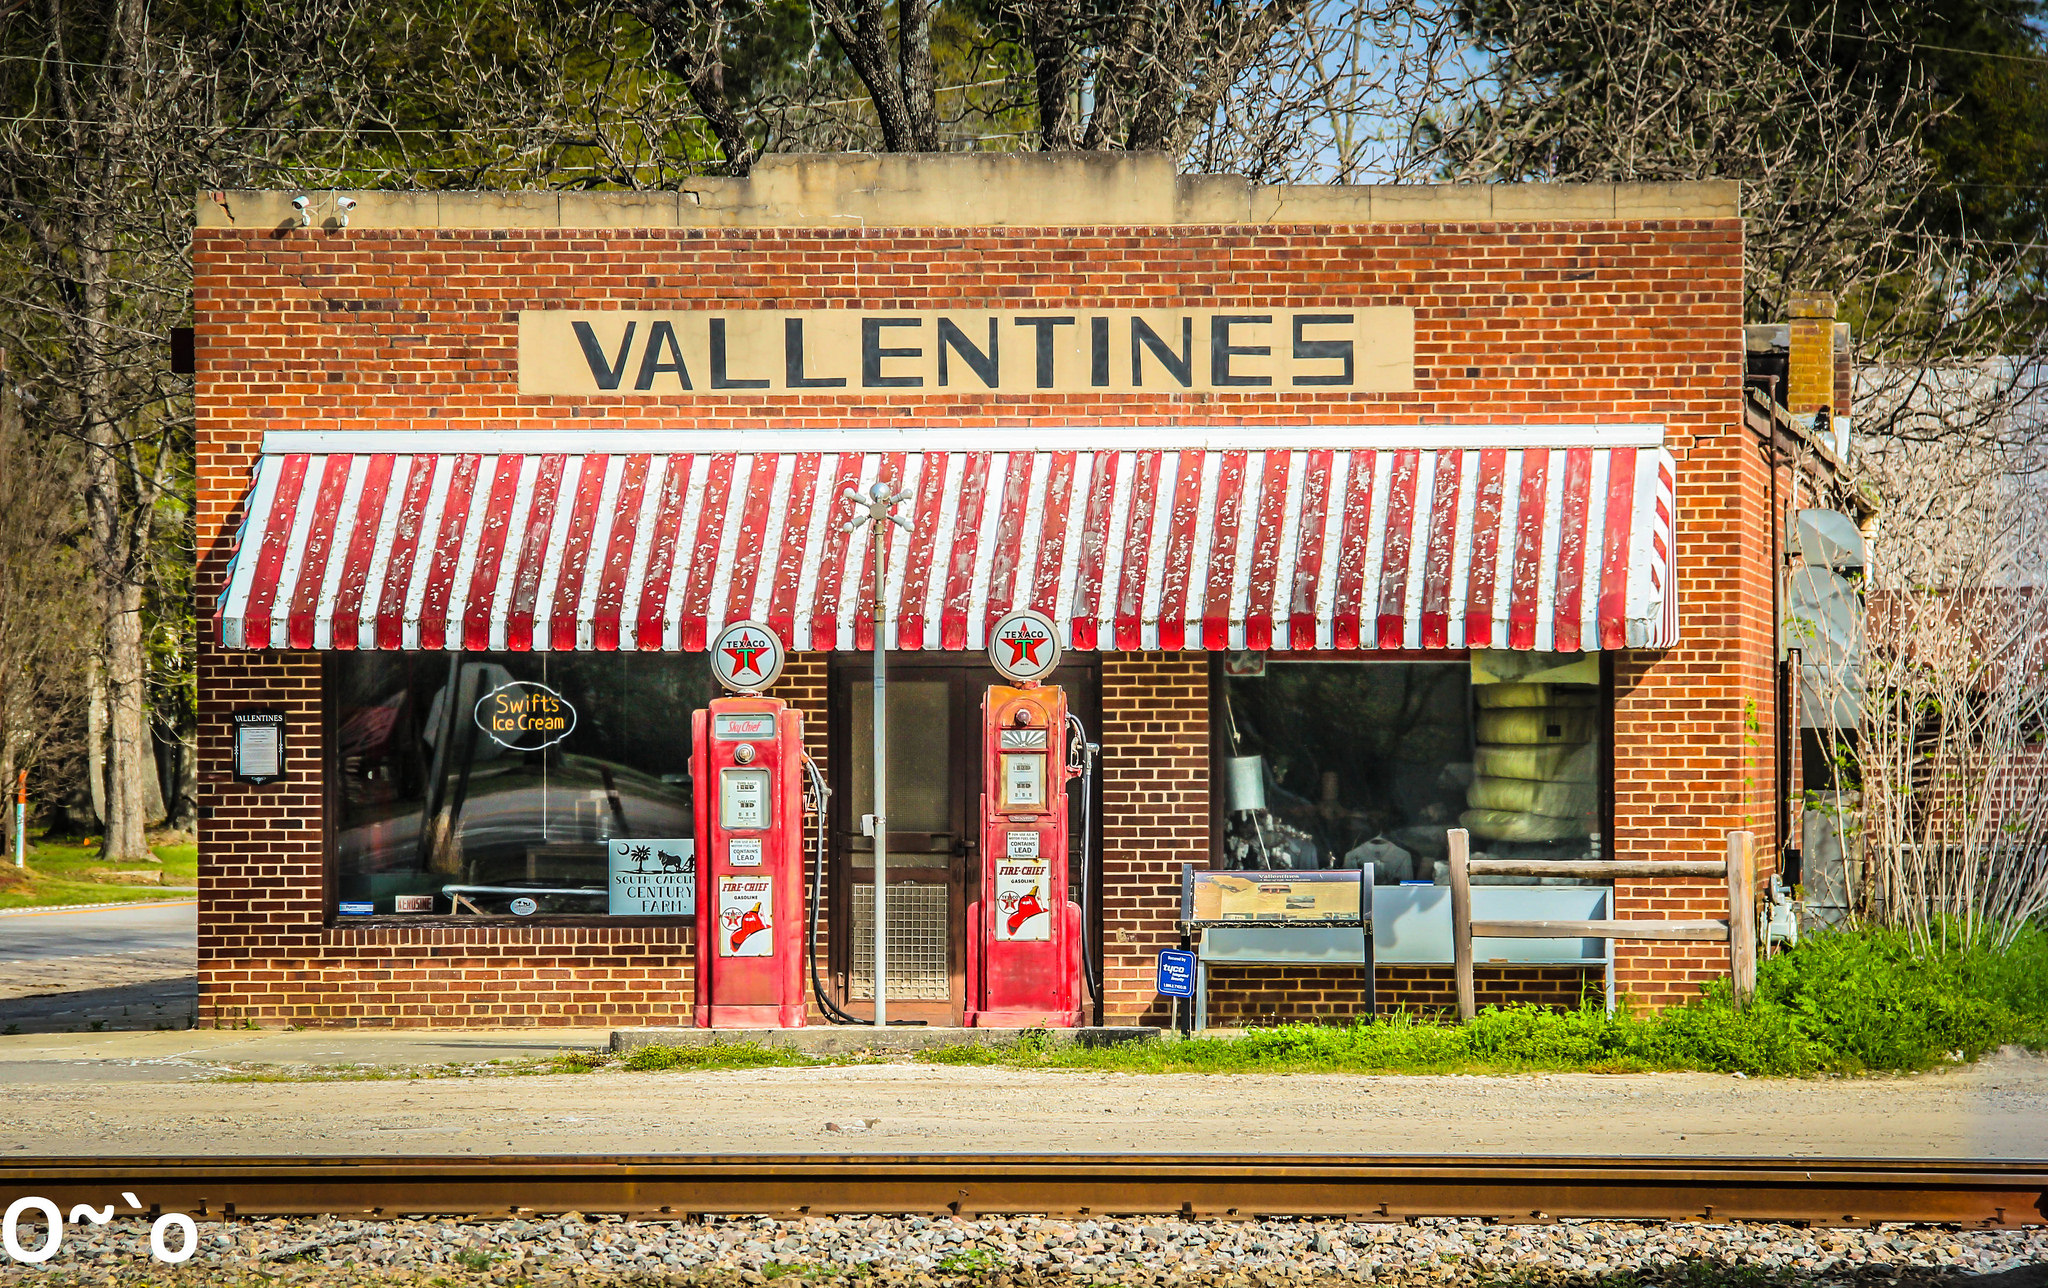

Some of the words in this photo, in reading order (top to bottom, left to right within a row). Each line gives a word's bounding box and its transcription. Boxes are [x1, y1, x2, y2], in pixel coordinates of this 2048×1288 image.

[571, 313, 1355, 390] VALLENTINES
[1005, 630, 1044, 638] TEXACO
[726, 640, 765, 648] TEXACO
[496, 693, 560, 714] Swift's
[234, 714, 283, 722] VALLENTINES
[492, 715, 515, 731] Ice
[517, 713, 565, 731] Cream
[728, 721, 741, 733] Sky
[742, 721, 762, 732] Chief
[999, 866, 1047, 876] FIRE-CHIEF
[615, 875, 650, 885] SOUTH
[626, 886, 694, 898] CENTURY
[721, 882, 769, 892] FIRE-CHIEF
[641, 900, 682, 912] FARM
[1163, 963, 1185, 974] tyco
